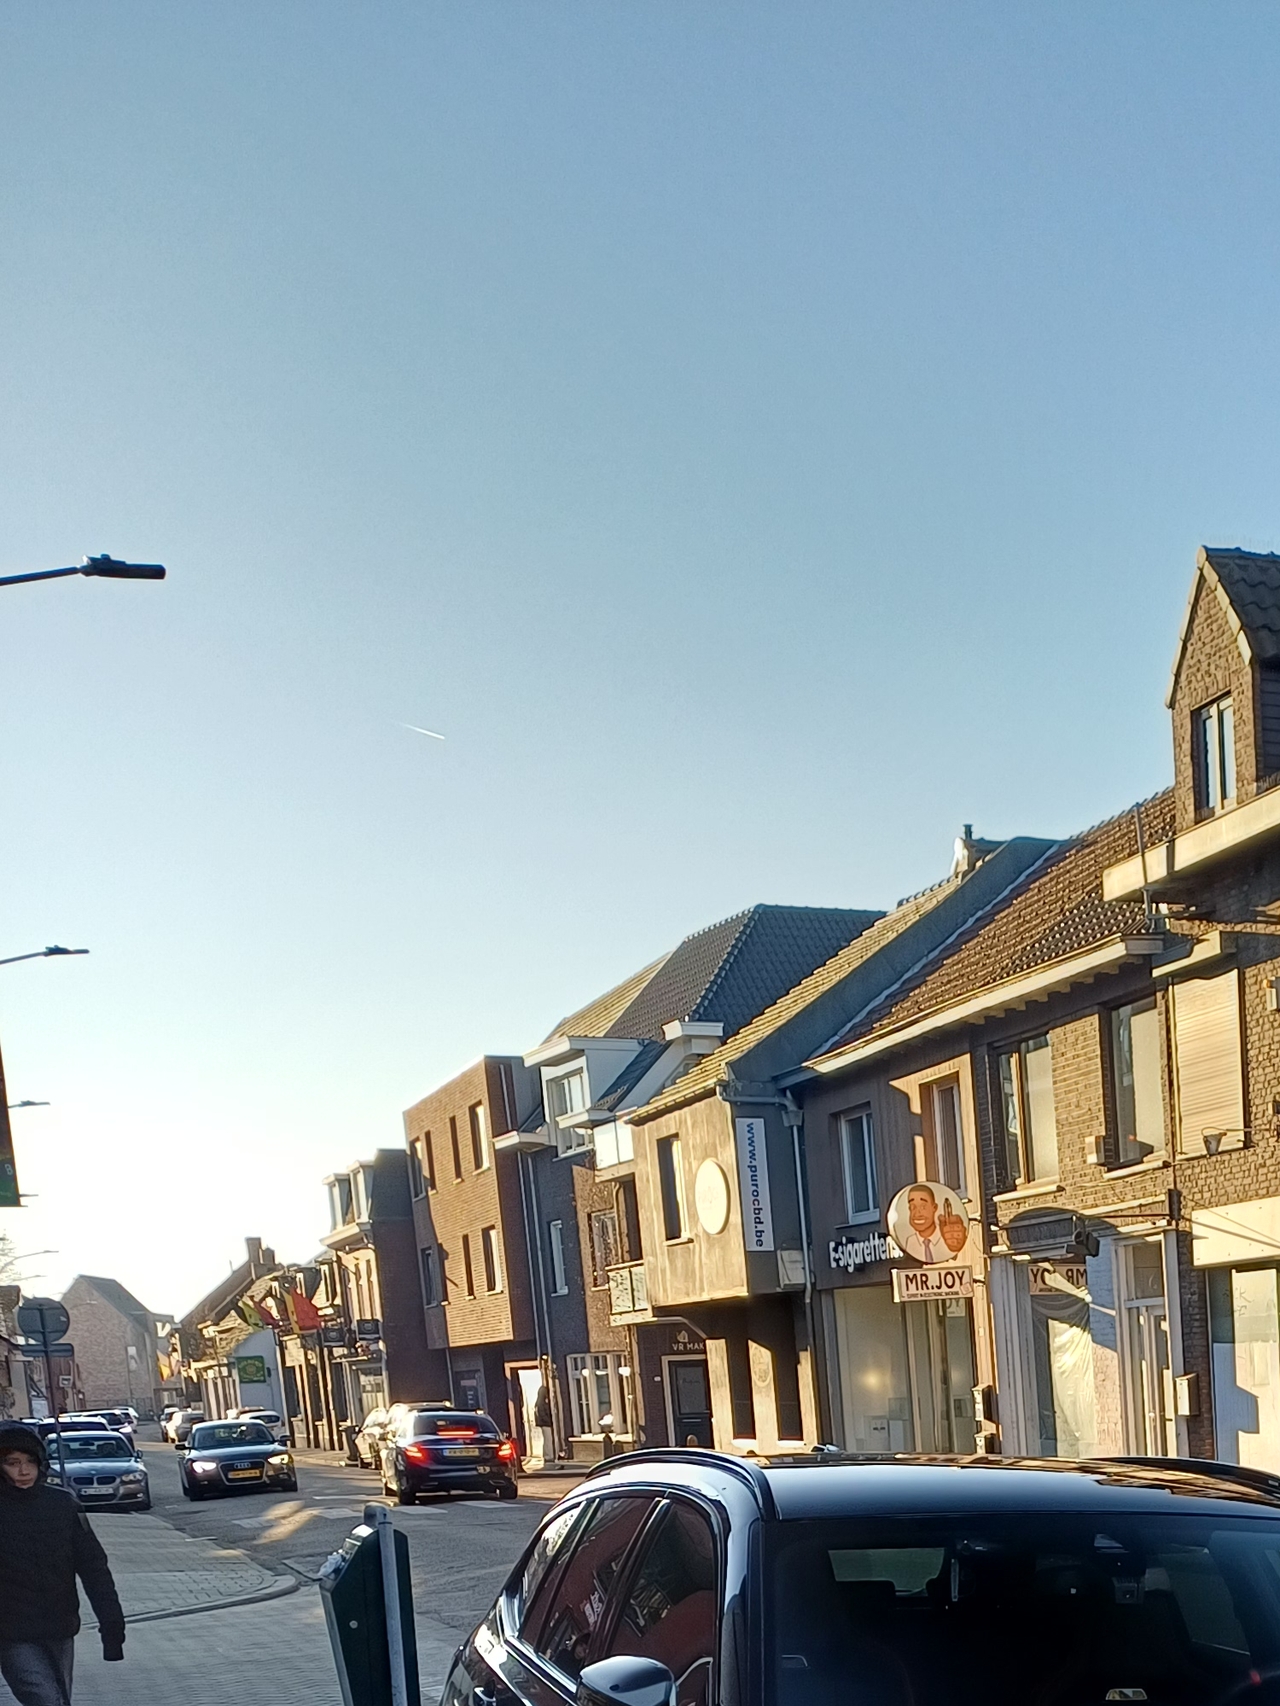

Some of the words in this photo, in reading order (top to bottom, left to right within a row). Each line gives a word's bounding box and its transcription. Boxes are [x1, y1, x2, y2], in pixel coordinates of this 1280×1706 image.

[746, 1122, 765, 1248] www.purocbd.be
[905, 1270, 965, 1292] MR.JOY
[686, 1341, 704, 1350] MAK
